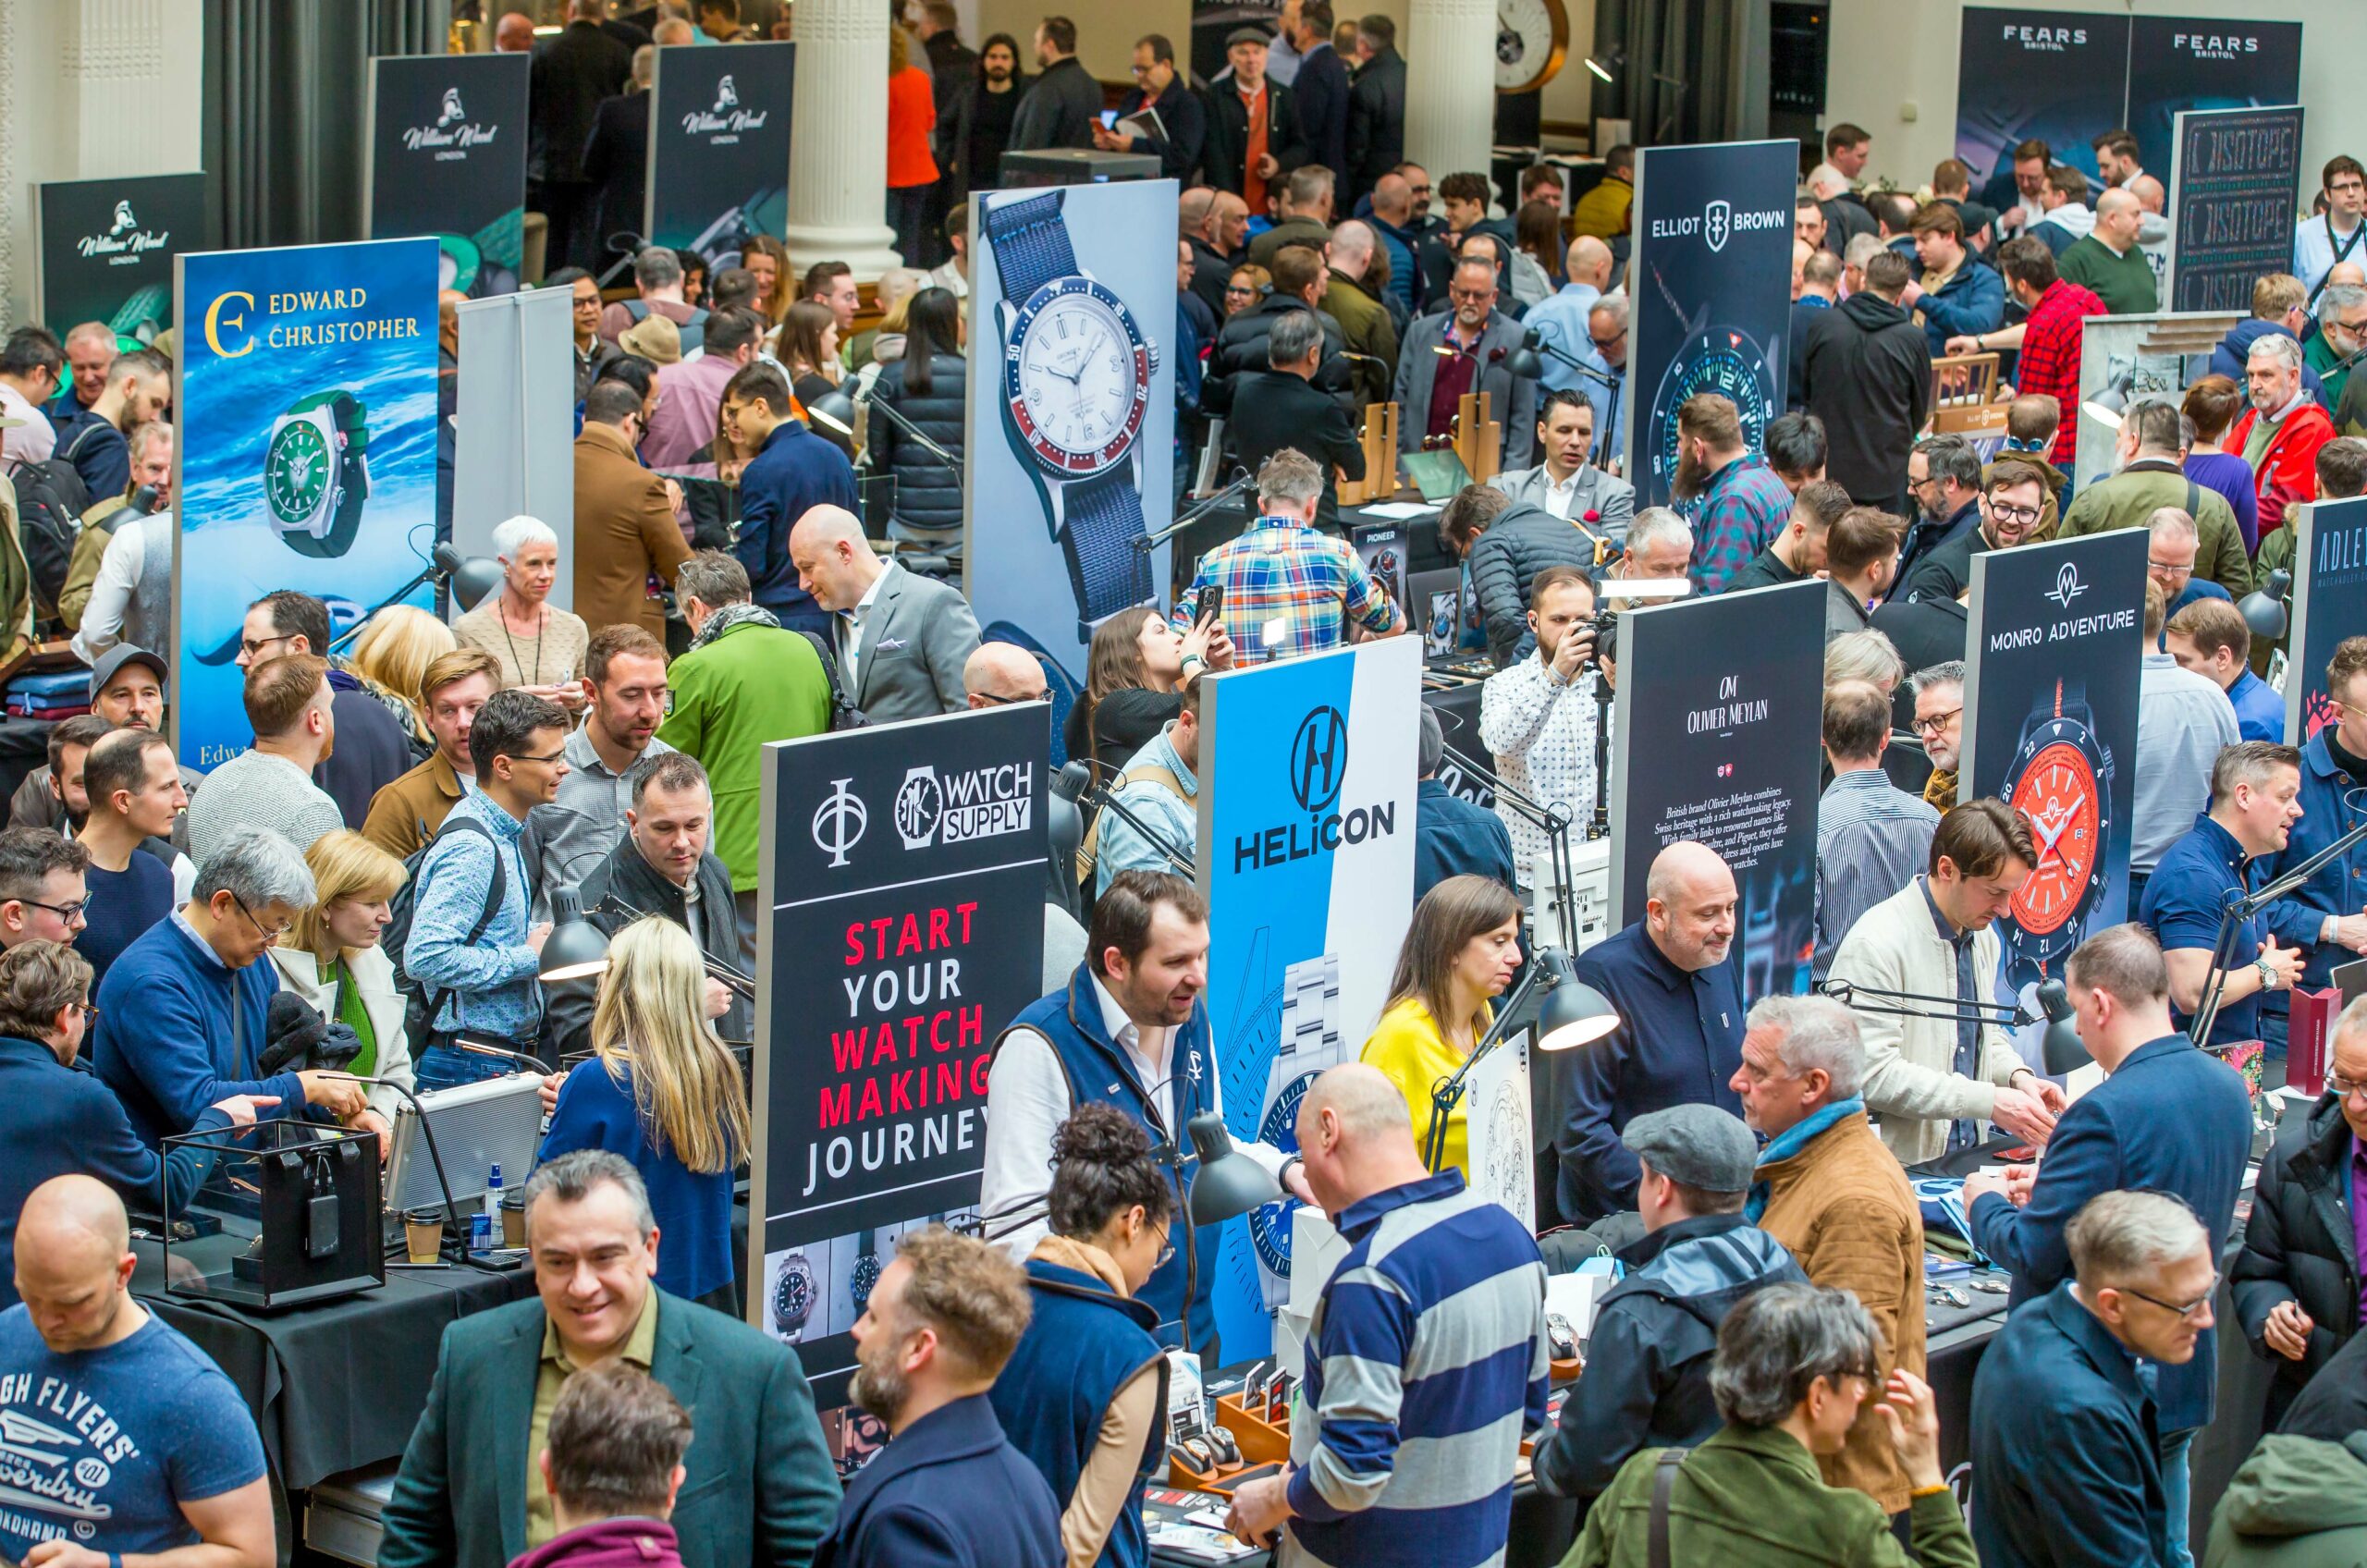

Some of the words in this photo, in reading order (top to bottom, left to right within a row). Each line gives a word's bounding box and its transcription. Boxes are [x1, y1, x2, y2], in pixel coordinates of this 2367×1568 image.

[2004, 25, 2088, 44] FEARS
[2175, 33, 2258, 52] FEARS
[2023, 41, 2066, 52] BRISTOL
[2195, 49, 2236, 60] BRISTOL
[1652, 216, 1700, 238] ELLIOT
[1734, 210, 1785, 231] BROWN
[269, 288, 367, 314] EDWARD
[1113, 301, 1126, 317] 10
[268, 317, 421, 349] CHRISTOPHER
[1007, 344, 1021, 361] 50
[1718, 371, 1735, 391] 12
[1135, 383, 1147, 402] 20
[1094, 448, 1108, 467] 30
[1367, 530, 1396, 544] PIONEER
[1991, 626, 2042, 653] MONRO
[2048, 609, 2136, 643] ADVENTURE
[1687, 706, 1726, 734] OLIVIER
[1729, 698, 1768, 726] MEYLAN
[2079, 730, 2086, 744] 2
[2024, 741, 2036, 759] 22
[944, 761, 1033, 808] WATCH
[2002, 783, 2013, 802] 20
[1666, 803, 1687, 819] British
[1688, 800, 1708, 814] brand
[1708, 797, 1729, 810] Olivier
[1729, 792, 1753, 807] Meylan
[1753, 787, 1783, 801] combines
[946, 801, 1028, 840] SUPPLY
[1654, 822, 1673, 835] Swiss
[1673, 818, 1699, 831] heritage
[1699, 813, 1713, 825] with
[1718, 809, 1731, 821] rich
[1732, 802, 1772, 818] watchmaking
[1662, 833, 1678, 846] With
[1699, 826, 1715, 839] links
[1715, 827, 1723, 835] to
[1723, 816, 1753, 834] renowned
[1753, 815, 1772, 827] names
[1772, 810, 1785, 822] like
[1724, 833, 1737, 846] and
[1737, 831, 1759, 846] Piguet,
[1759, 827, 1772, 840] they
[1772, 823, 1788, 836] offer
[1723, 848, 1739, 860] dress
[1739, 842, 1752, 856] and
[1752, 841, 1771, 856] sports
[1771, 838, 1784, 850] luxe
[1733, 856, 1759, 870] watches.
[2091, 874, 2099, 886] 8
[845, 901, 978, 966] START
[2040, 938, 2050, 954] 12
[843, 958, 962, 1017] YOUR
[831, 1004, 983, 1073] WATCH
[819, 1053, 990, 1130] MAKING
